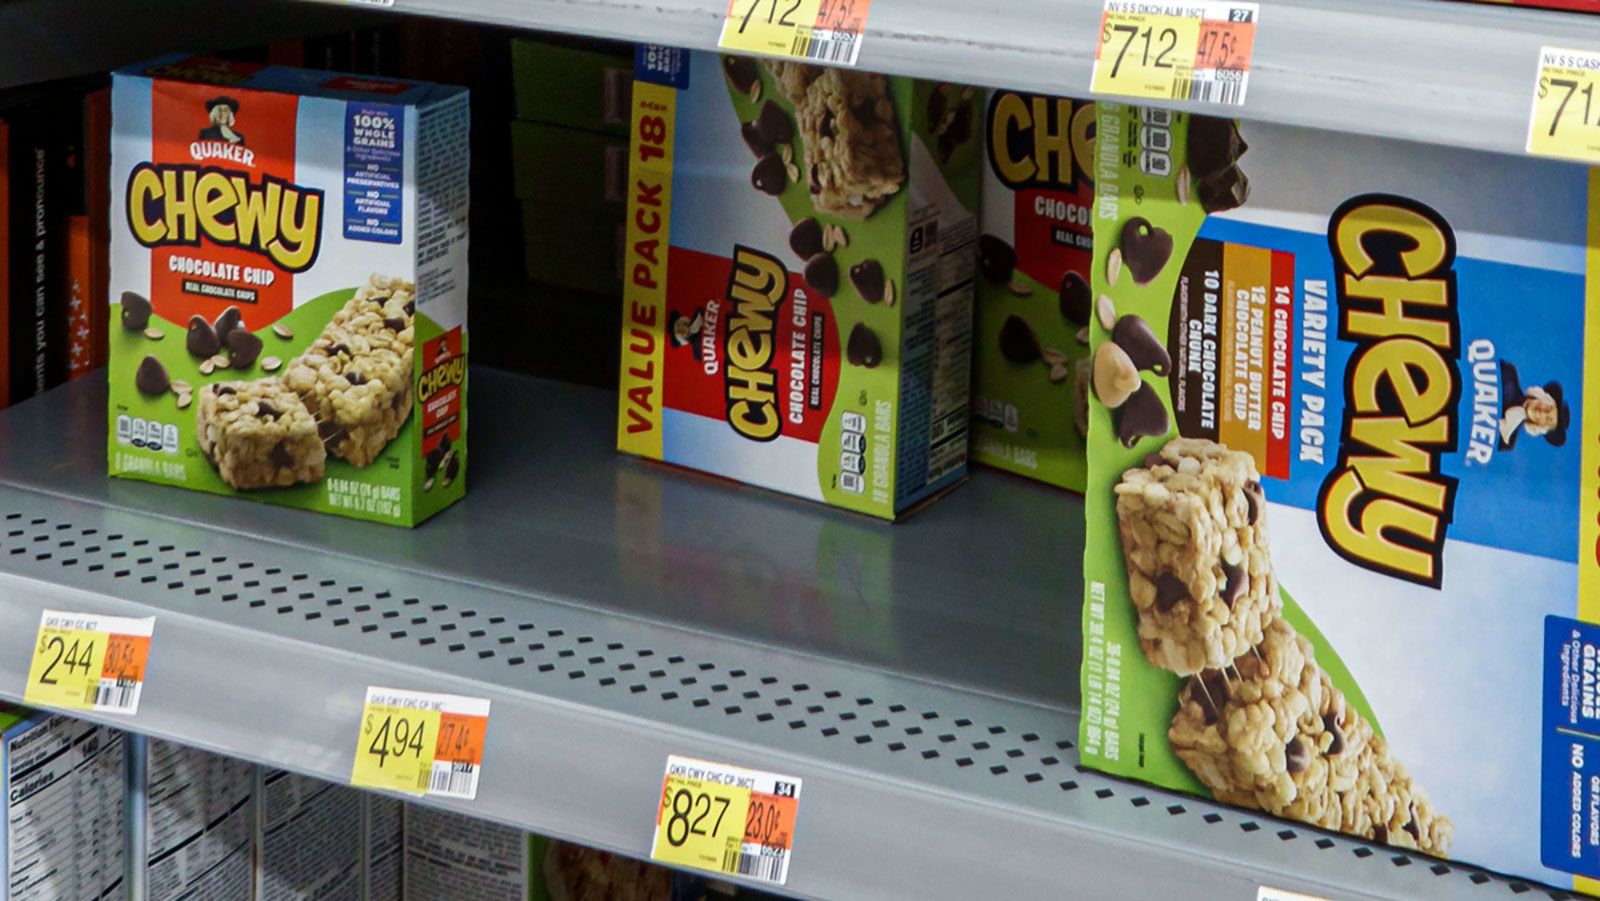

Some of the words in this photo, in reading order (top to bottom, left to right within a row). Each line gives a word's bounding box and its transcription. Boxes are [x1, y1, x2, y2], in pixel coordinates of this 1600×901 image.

[1108, 3, 1121, 12] NV
[1122, 4, 1128, 13] S
[1129, 5, 1136, 14] S
[1137, 5, 1162, 16] DKCH
[1164, 7, 1183, 17] ALM
[1185, 9, 1206, 19] 15CT
[1232, 9, 1248, 21] 27
[1544, 54, 1558, 65] NV
[1559, 55, 1566, 66] S
[1567, 56, 1574, 68] S
[353, 114, 395, 130] 100%
[1538, 77, 1600, 137] $71
[353, 128, 395, 139] WHOLE
[353, 137, 395, 149] GRAINS
[639, 114, 667, 163] 18
[1099, 114, 1120, 179] GRANOLA
[189, 142, 256, 167] QUAKER
[366, 163, 379, 172] NO
[36, 149, 47, 235] pronounce
[366, 190, 380, 200] NO
[1098, 182, 1119, 220] BARS
[366, 217, 380, 227] NO
[1035, 195, 1092, 227] CHOCO
[36, 239, 45, 252] &
[632, 179, 664, 290] PACK
[1056, 230, 1074, 243] REAL
[36, 254, 45, 283] see
[169, 255, 240, 281] CHOCOLATE
[243, 267, 275, 286] CHIP
[1204, 270, 1219, 290] 10
[36, 287, 45, 317] can
[793, 288, 808, 327] CHIP
[1250, 285, 1266, 305] 12
[1274, 285, 1290, 305] 14
[1203, 292, 1218, 336] DARK
[36, 321, 47, 350] you
[702, 300, 720, 376] QUAKER
[1188, 319, 1202, 373] CHUNK
[1235, 289, 1250, 379] CHOCOLATE
[1249, 307, 1264, 368] PEANUT
[1301, 279, 1328, 390] VARIETY
[627, 301, 657, 435] VALUE
[811, 341, 821, 386] CHOCOLATE
[1272, 308, 1289, 398] CHOCOLATE
[789, 331, 807, 424] CHOCOLATE
[1201, 335, 1217, 430] CHOCOLATE
[810, 390, 820, 405] REAL
[1234, 383, 1248, 421] CHIP
[1248, 372, 1263, 431] BUTTER
[1466, 339, 1501, 469] QUAKER
[875, 400, 892, 432] BARS
[1271, 401, 1287, 440] CHIP
[1299, 393, 1325, 465] PACK
[1090, 580, 1105, 602] NET
[1572, 629, 1581, 639] &
[1571, 640, 1580, 672] Other
[1561, 644, 1571, 706] Ingredients
[1582, 644, 1596, 719] GRAINS
[1570, 673, 1580, 724] Delicious
[10, 725, 49, 753] Nutrition
[1104, 730, 1119, 761] BARS
[1571, 743, 1584, 768] NO
[10, 771, 54, 802] Calories
[669, 764, 686, 775] QKR
[688, 767, 705, 779] CWY
[706, 770, 723, 784] CHC
[724, 774, 736, 785] CP
[777, 783, 791, 796] 34
[1590, 776, 1600, 793] OR
[1572, 771, 1582, 812] ADDED
[1572, 812, 1582, 858] COLORS
[1590, 794, 1600, 846] FLAVORS
